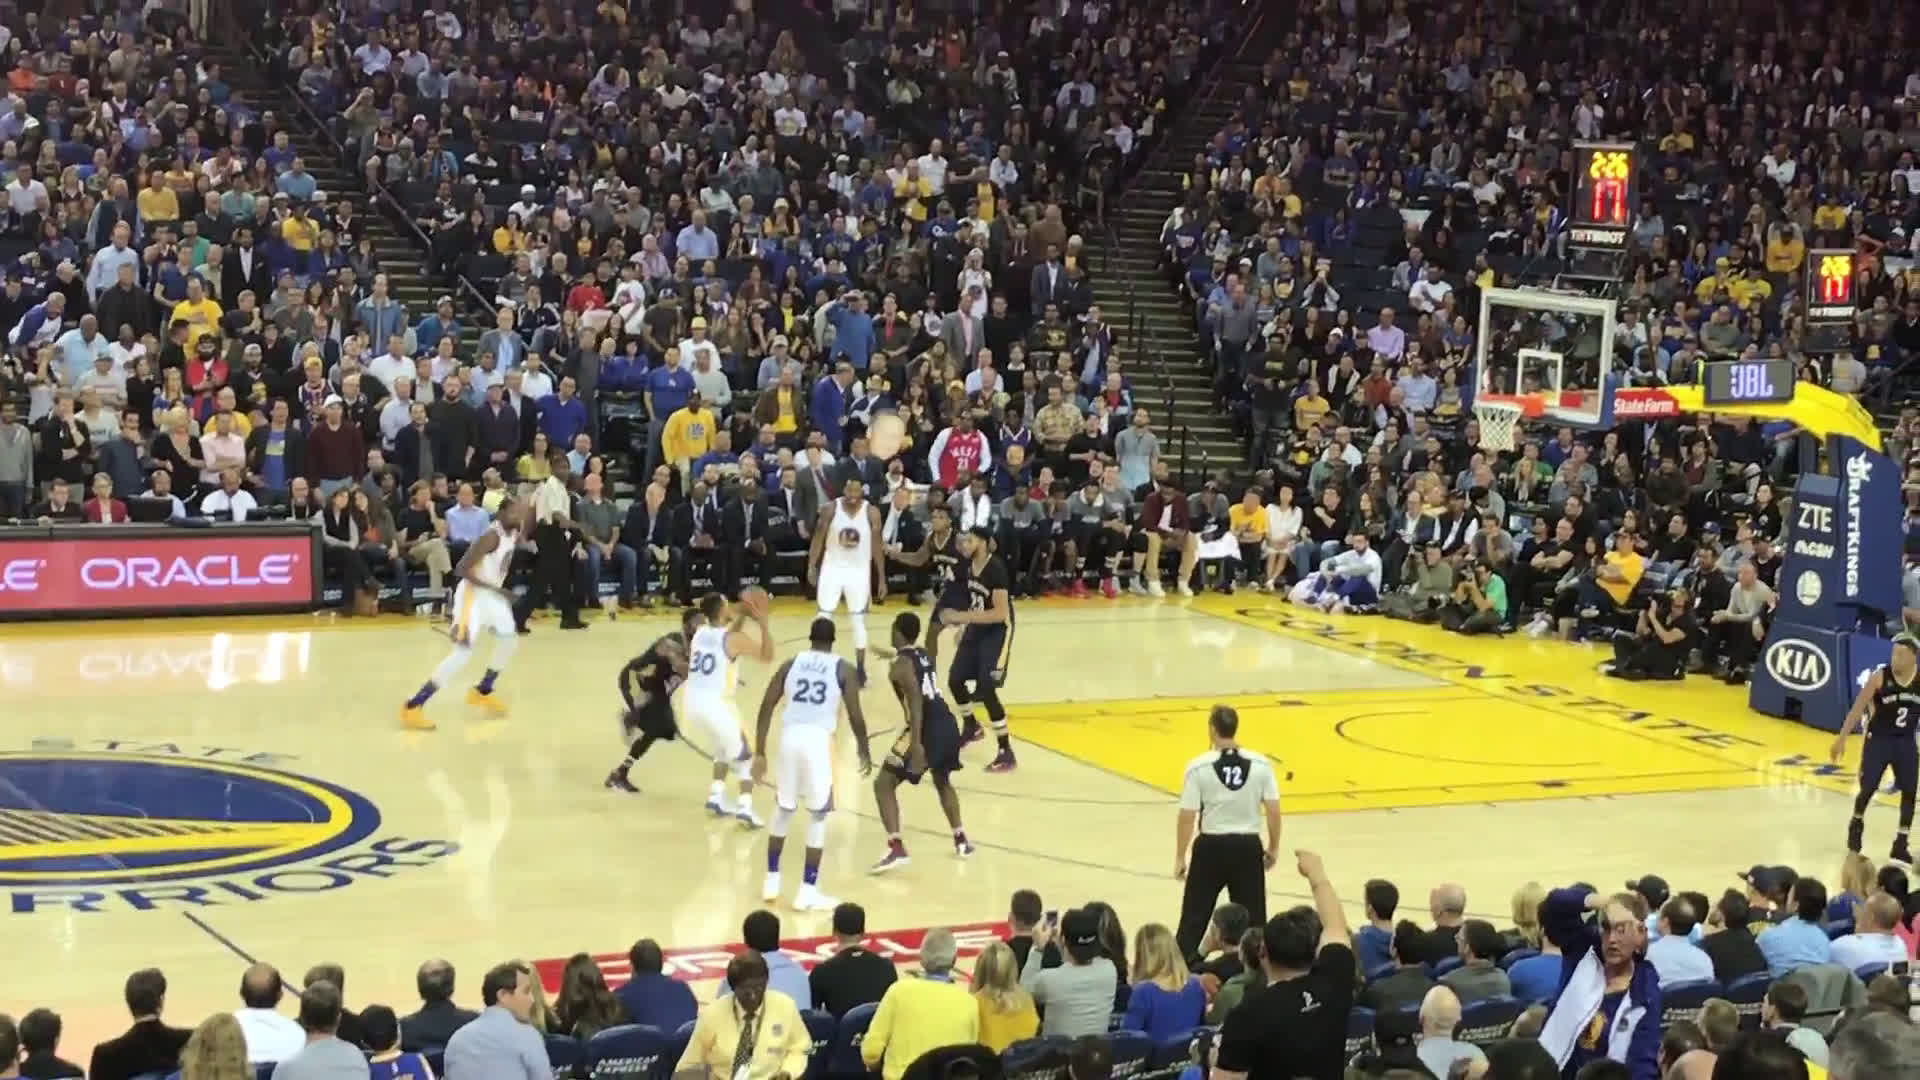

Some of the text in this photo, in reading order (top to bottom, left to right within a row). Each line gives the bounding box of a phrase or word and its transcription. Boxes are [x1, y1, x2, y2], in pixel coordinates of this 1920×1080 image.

[1594, 181, 1622, 222] 17
[1730, 363, 1774, 399] JBL
[1613, 397, 1674, 414] State Farm
[1798, 502, 1832, 533] ZTE
[1846, 455, 1868, 597] DRAFTKINGS
[0, 559, 39, 591] E
[80, 554, 293, 588] ORACLE
[689, 651, 716, 676] 30
[1775, 647, 1819, 683] KIA
[792, 678, 827, 705] 23
[1503, 683, 1765, 749] STATE
[1896, 707, 1908, 728] 2
[1222, 766, 1242, 785] 72
